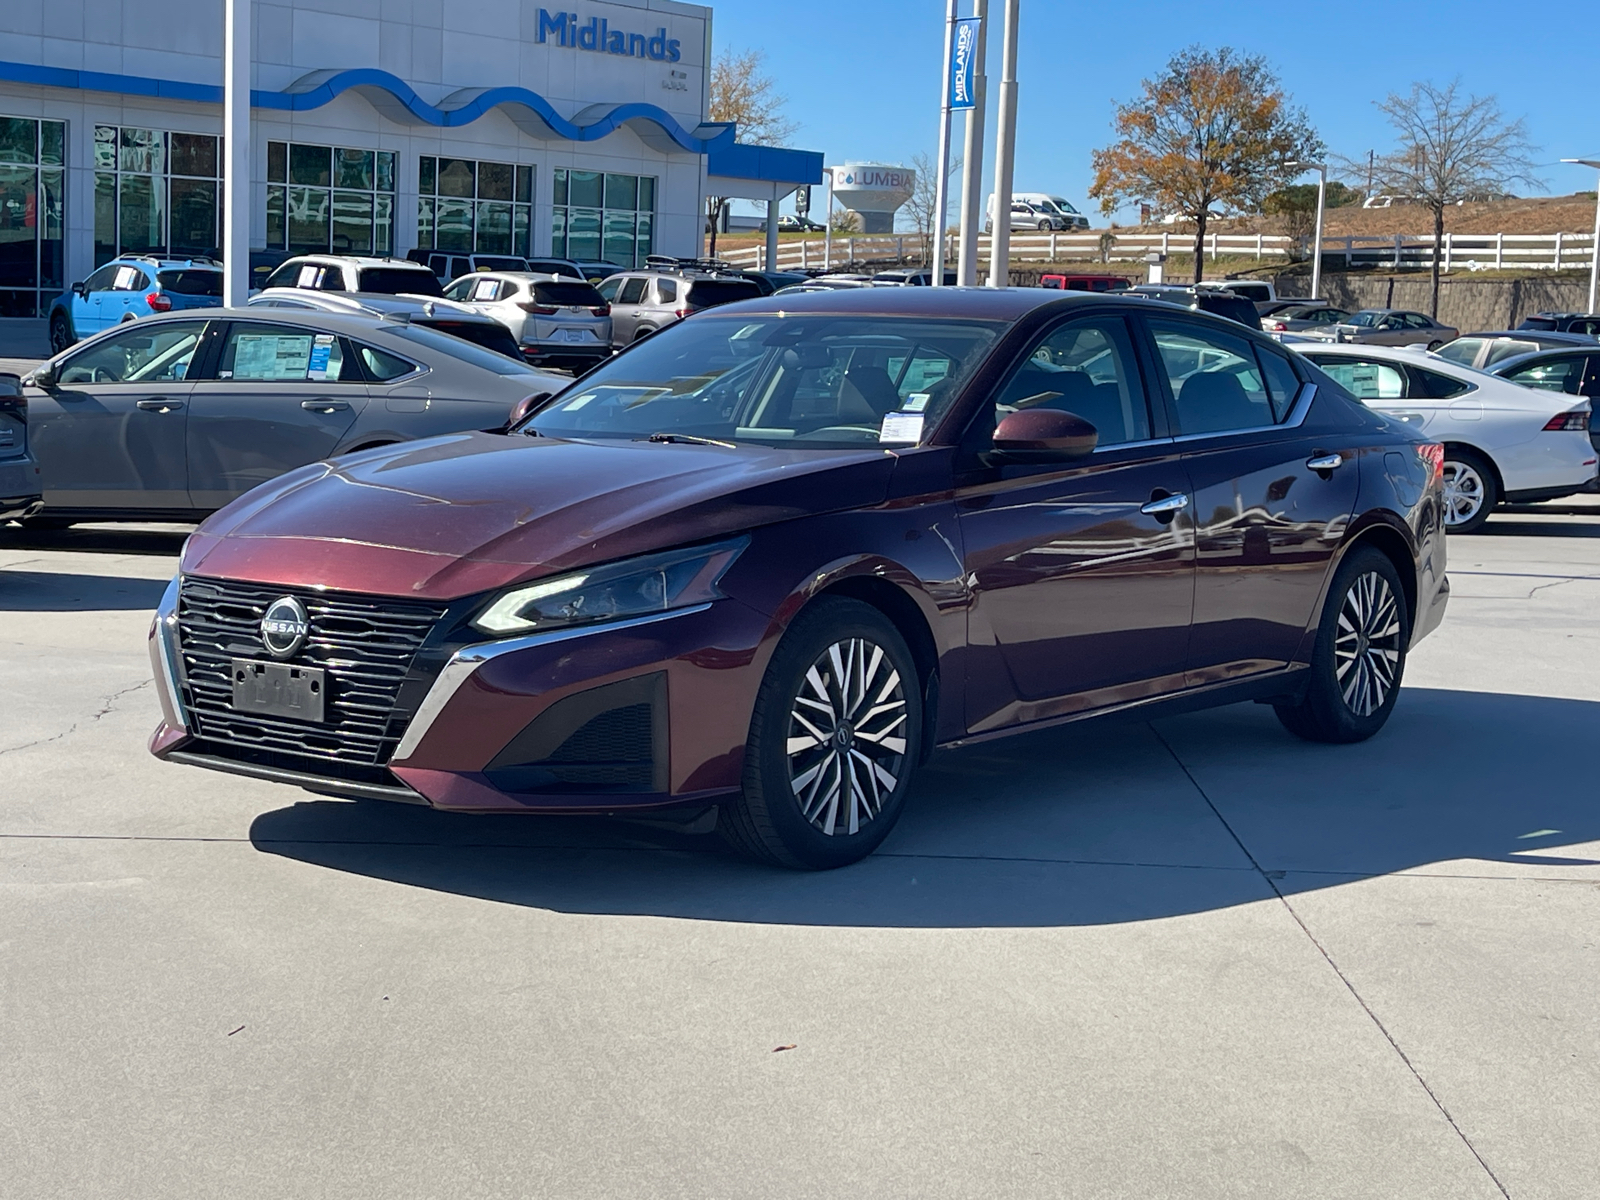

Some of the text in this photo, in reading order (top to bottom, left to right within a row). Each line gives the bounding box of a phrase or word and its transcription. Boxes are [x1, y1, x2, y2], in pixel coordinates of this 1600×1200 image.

[535, 8, 681, 62] Midlands
[955, 24, 969, 102] MIDLANDS
[261, 619, 307, 634] NISSAN
